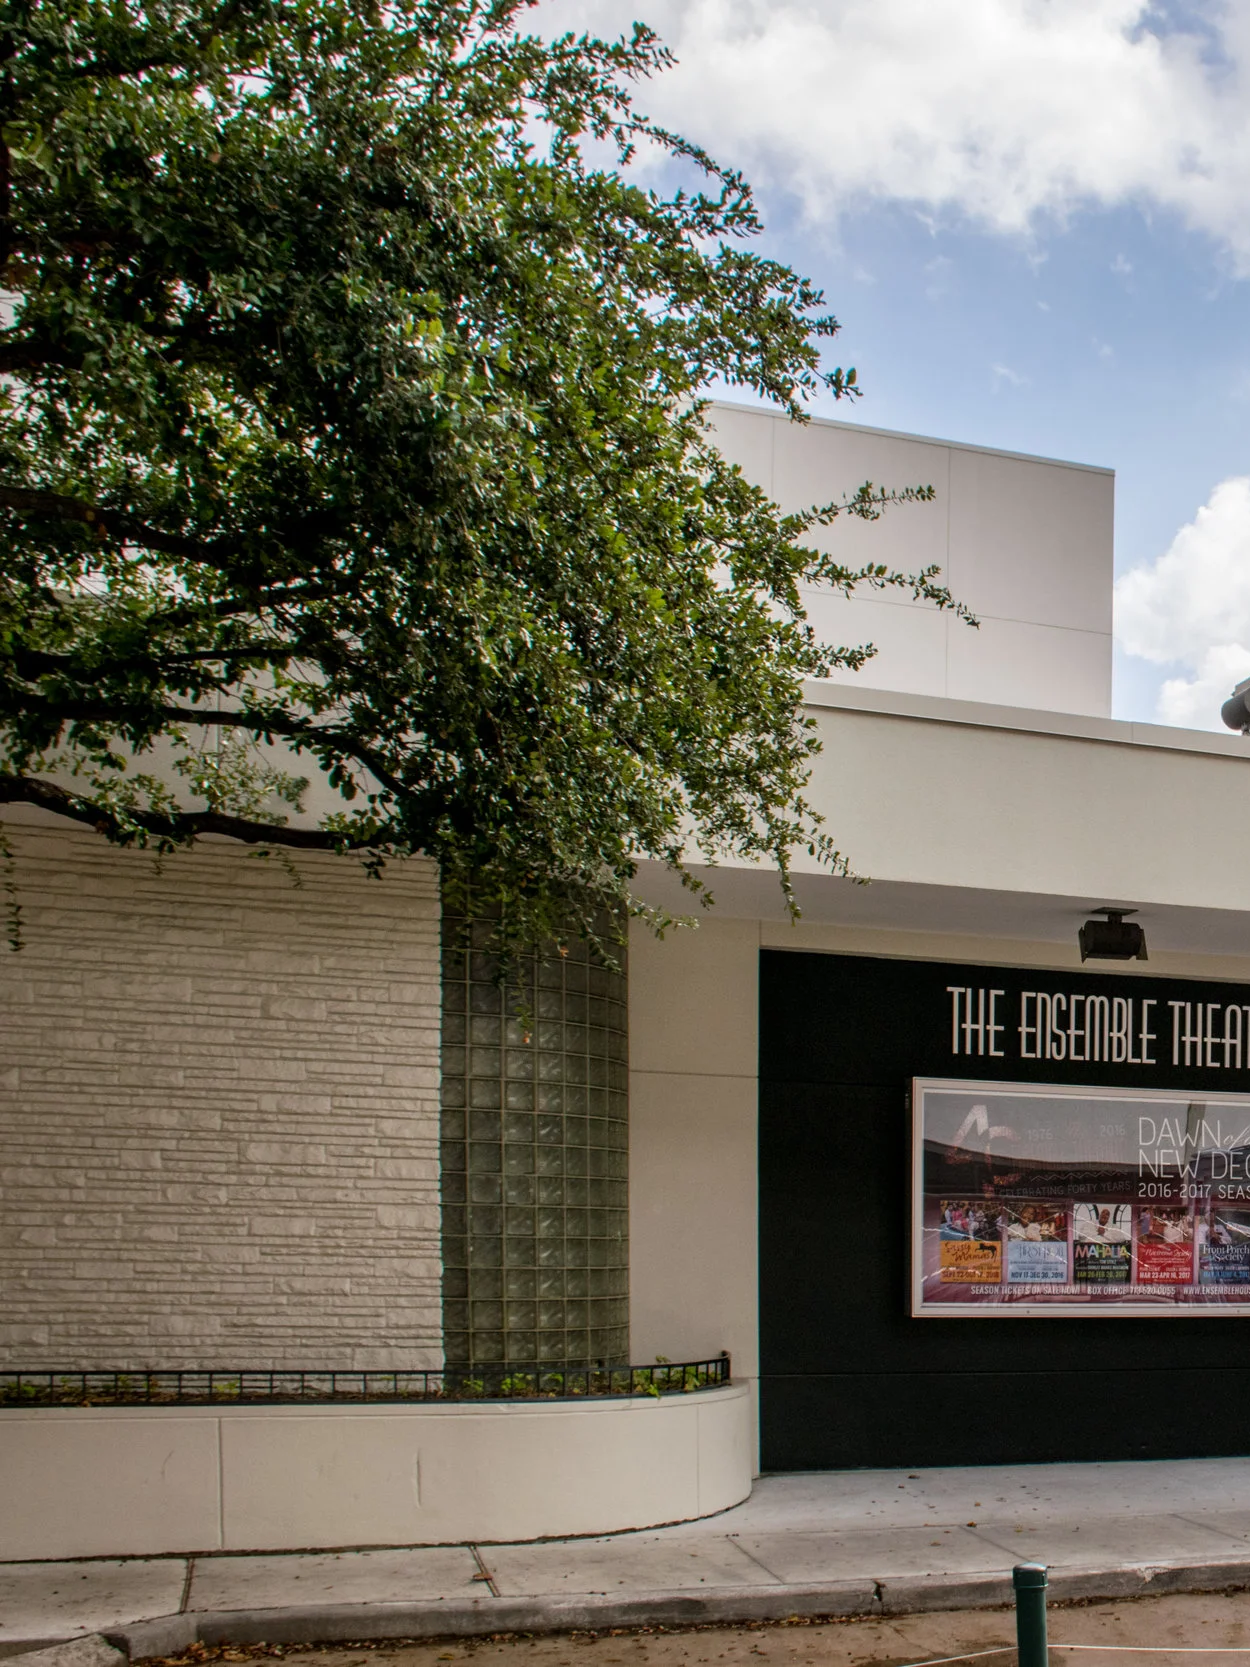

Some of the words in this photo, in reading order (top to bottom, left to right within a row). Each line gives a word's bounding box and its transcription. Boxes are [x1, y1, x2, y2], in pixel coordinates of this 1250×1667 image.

[946, 986, 1005, 1057] THE
[1017, 991, 1158, 1065] ENSEMBLE
[1100, 1124, 1126, 1137] 2016
[1138, 1117, 1221, 1148] DAWN
[1138, 1149, 1201, 1179] NEW
[1067, 1183, 1097, 1195] FORTY
[1100, 1180, 1131, 1192] YEARS
[1137, 1183, 1212, 1199] 2016-2017
[1075, 1244, 1130, 1259] MAHALIA
[1202, 1244, 1225, 1255] Front
[1226, 1244, 1250, 1255] Porch
[970, 1285, 999, 1295] SEASON
[1001, 1285, 1030, 1295] TICKETS
[1031, 1285, 1041, 1295] ON
[1042, 1285, 1061, 1295] SALE
[1087, 1285, 1102, 1295] BOX
